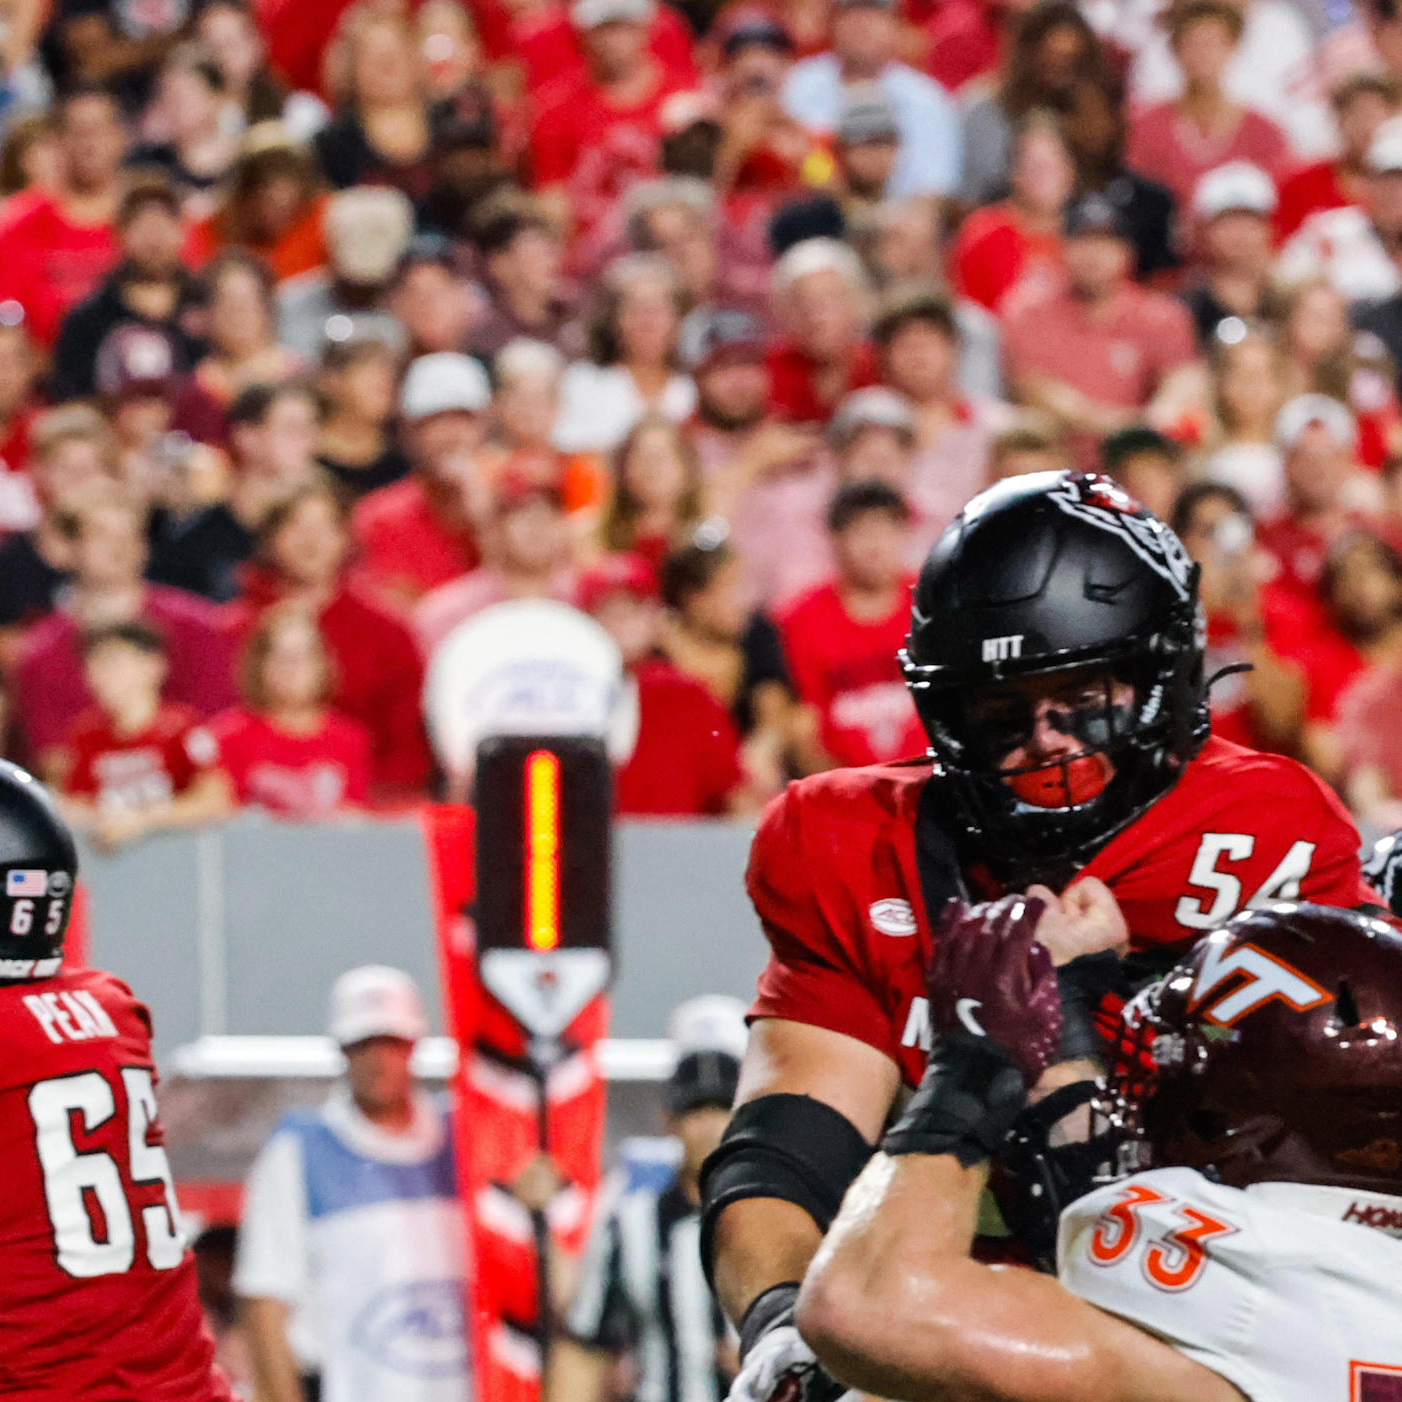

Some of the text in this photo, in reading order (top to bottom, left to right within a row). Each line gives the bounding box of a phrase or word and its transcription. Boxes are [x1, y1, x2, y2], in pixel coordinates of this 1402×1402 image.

[982, 635, 1024, 662] HTT
[1174, 832, 1316, 929] 54
[28, 1067, 184, 1278] 65
[1086, 1183, 1240, 1293] 33
